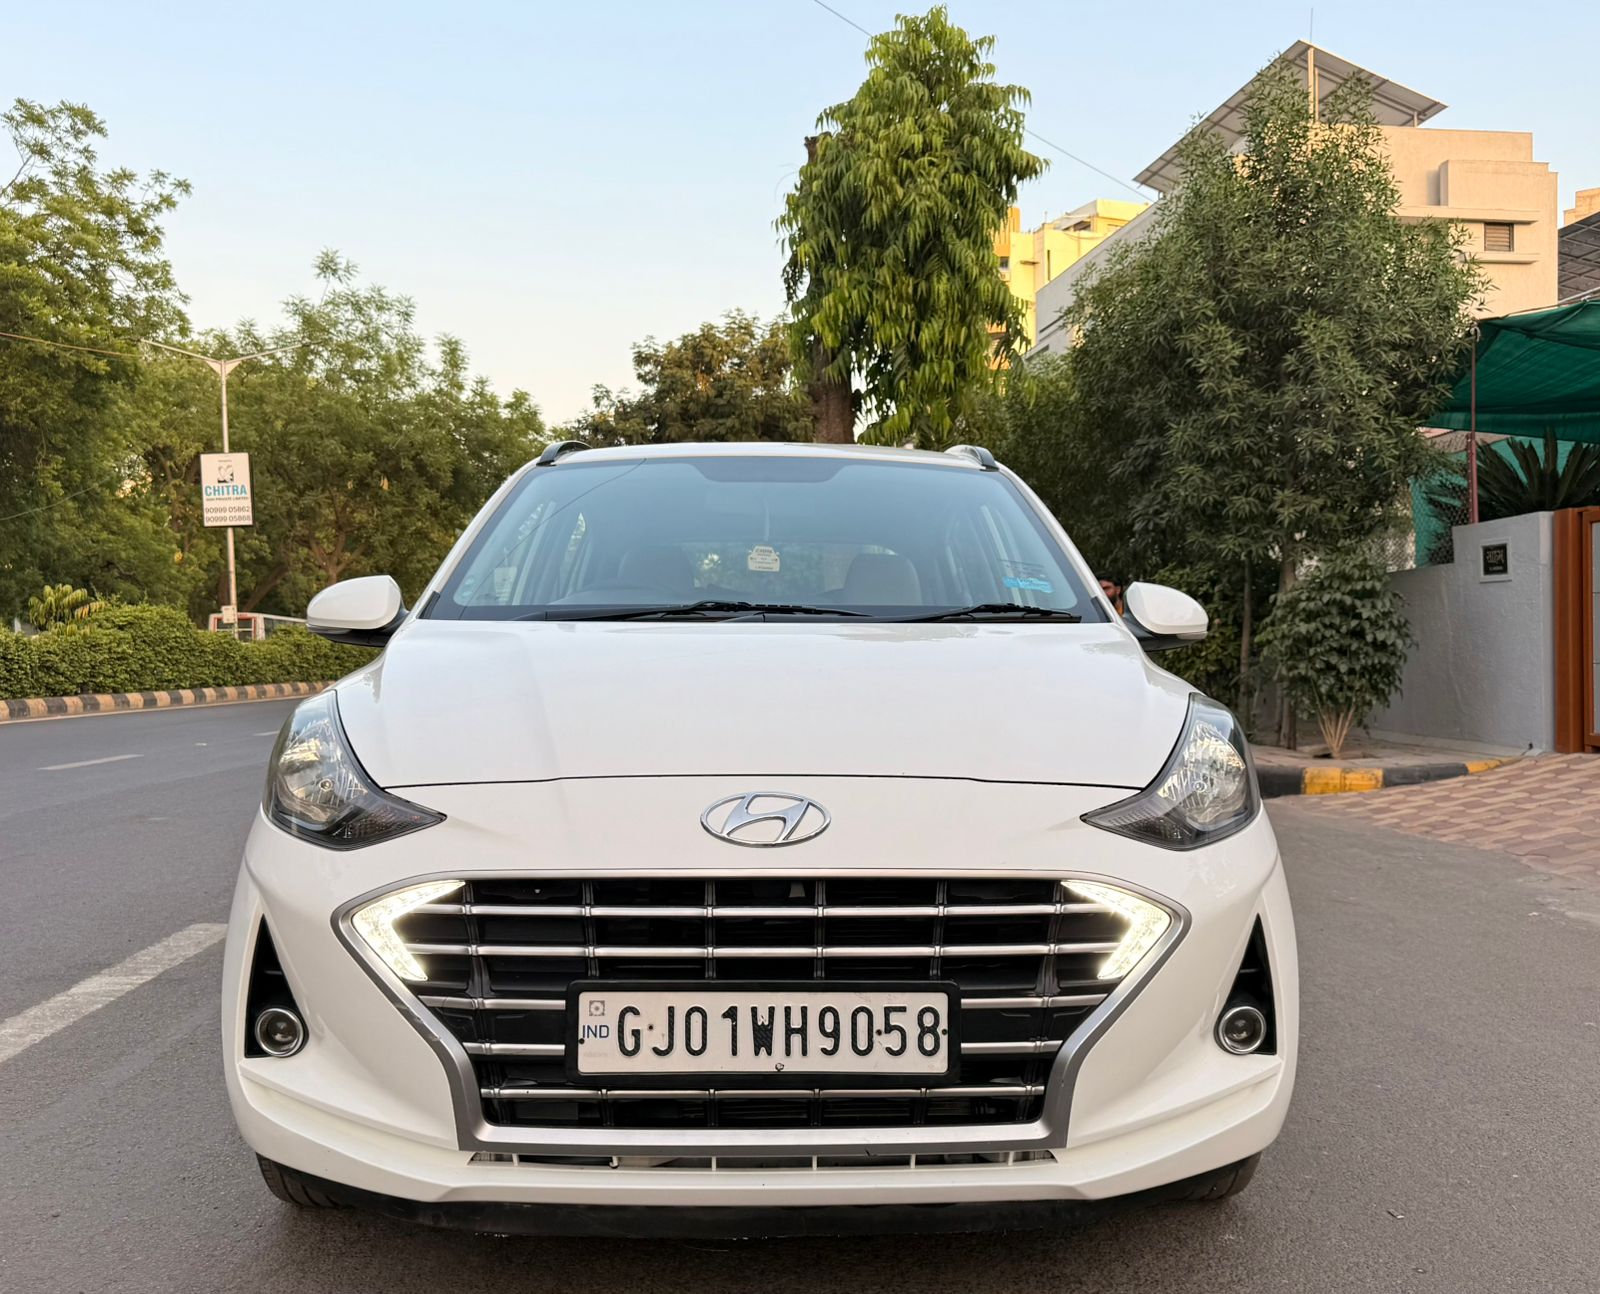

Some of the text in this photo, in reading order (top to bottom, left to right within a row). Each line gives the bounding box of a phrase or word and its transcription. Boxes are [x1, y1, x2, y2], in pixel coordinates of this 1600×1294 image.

[204, 484, 247, 496] CHITRA
[582, 1024, 610, 1039] IND
[617, 1005, 941, 1057] GJ01WH9058
